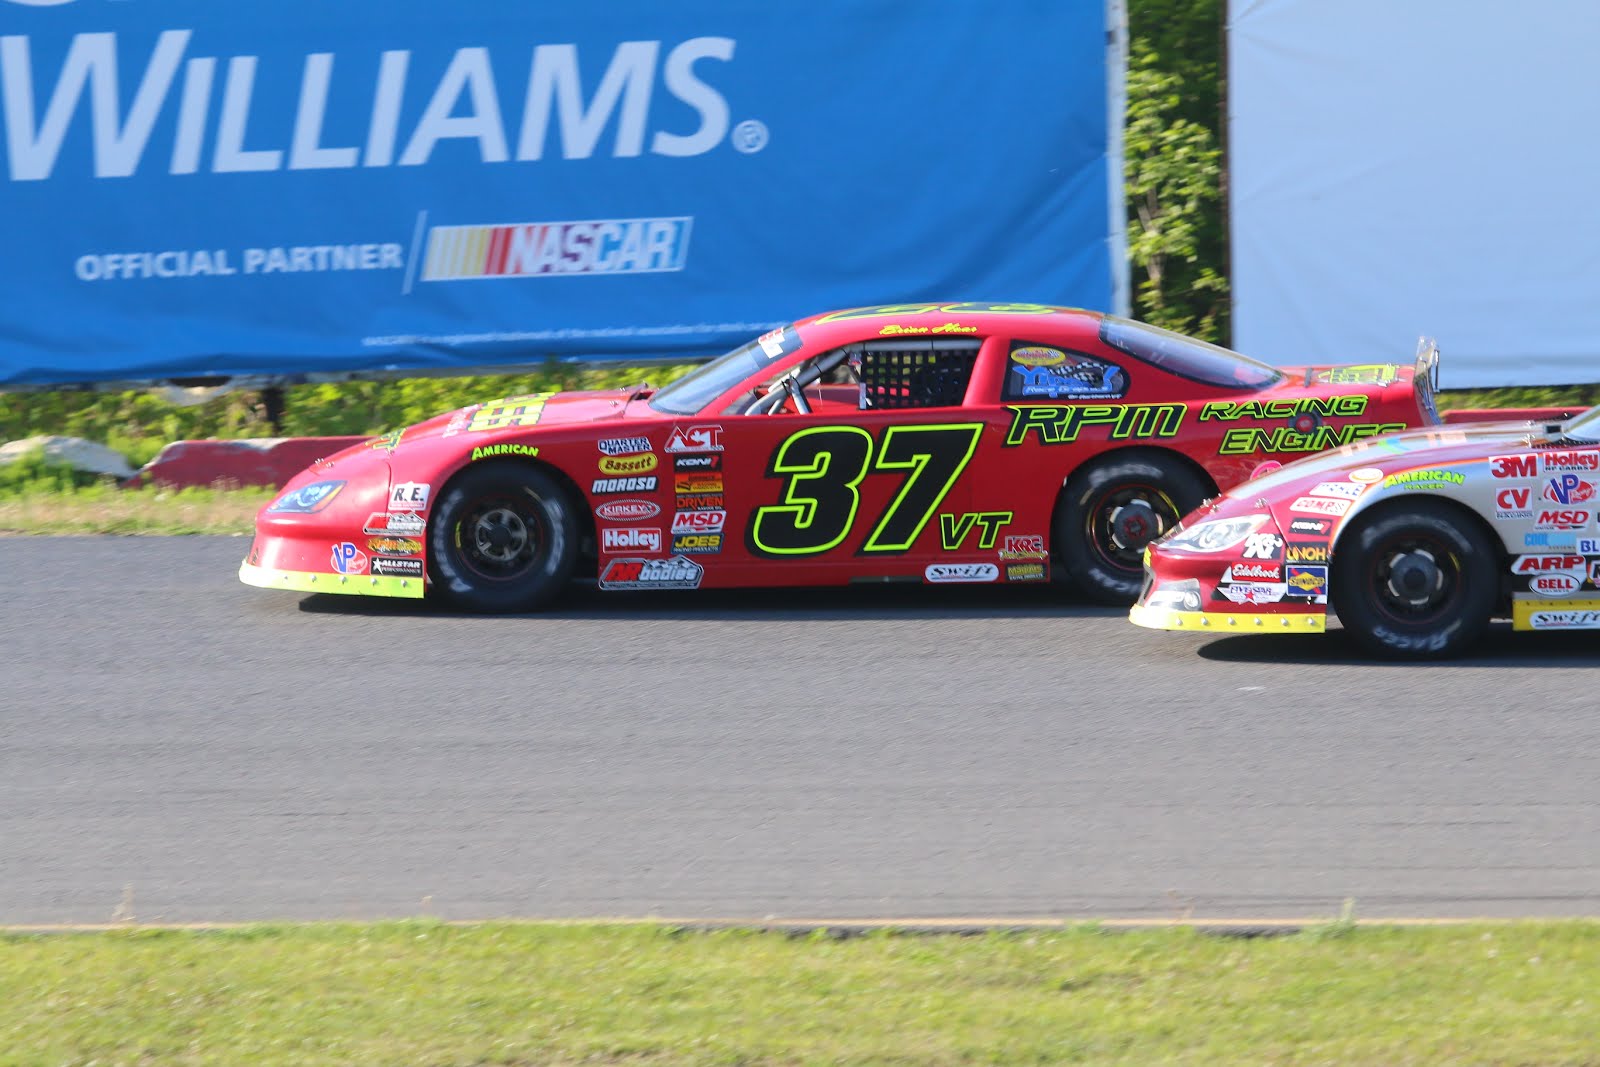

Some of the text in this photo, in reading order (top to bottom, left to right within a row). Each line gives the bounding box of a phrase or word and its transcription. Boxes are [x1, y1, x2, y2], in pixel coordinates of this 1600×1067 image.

[0, 29, 737, 181] WILLIAMS
[503, 221, 676, 274] NASCAR
[75, 242, 403, 281] OFFICIAL PARTNER
[1199, 394, 1369, 422] RACING
[599, 437, 648, 450] QUARTER
[608, 443, 651, 455] MASTER
[471, 444, 539, 461] AMERICAN
[605, 456, 652, 470] Bassett
[1491, 456, 1537, 478] 3M
[1545, 453, 1599, 470] Holley
[592, 476, 657, 493] MOROSO
[1383, 470, 1466, 490] AMERICAN
[747, 421, 1013, 557] 37 VT
[1550, 474, 1579, 505] VP
[677, 497, 723, 510] DRIVEN
[1497, 489, 1530, 509] CV
[603, 505, 649, 514] KIRKEY
[1538, 511, 1589, 524] MSD
[675, 512, 723, 527] MSD
[605, 529, 660, 551] Holley
[674, 535, 720, 548] JOES
[1007, 537, 1043, 553] KRC
[333, 544, 356, 573] VP
[1286, 546, 1326, 560] UNOH
[380, 560, 420, 568] ALLSTAR
[1519, 555, 1585, 571] ARP
[639, 565, 697, 580] bodies
[1289, 577, 1325, 586] SUNOCO
[1537, 579, 1574, 589] BELL
